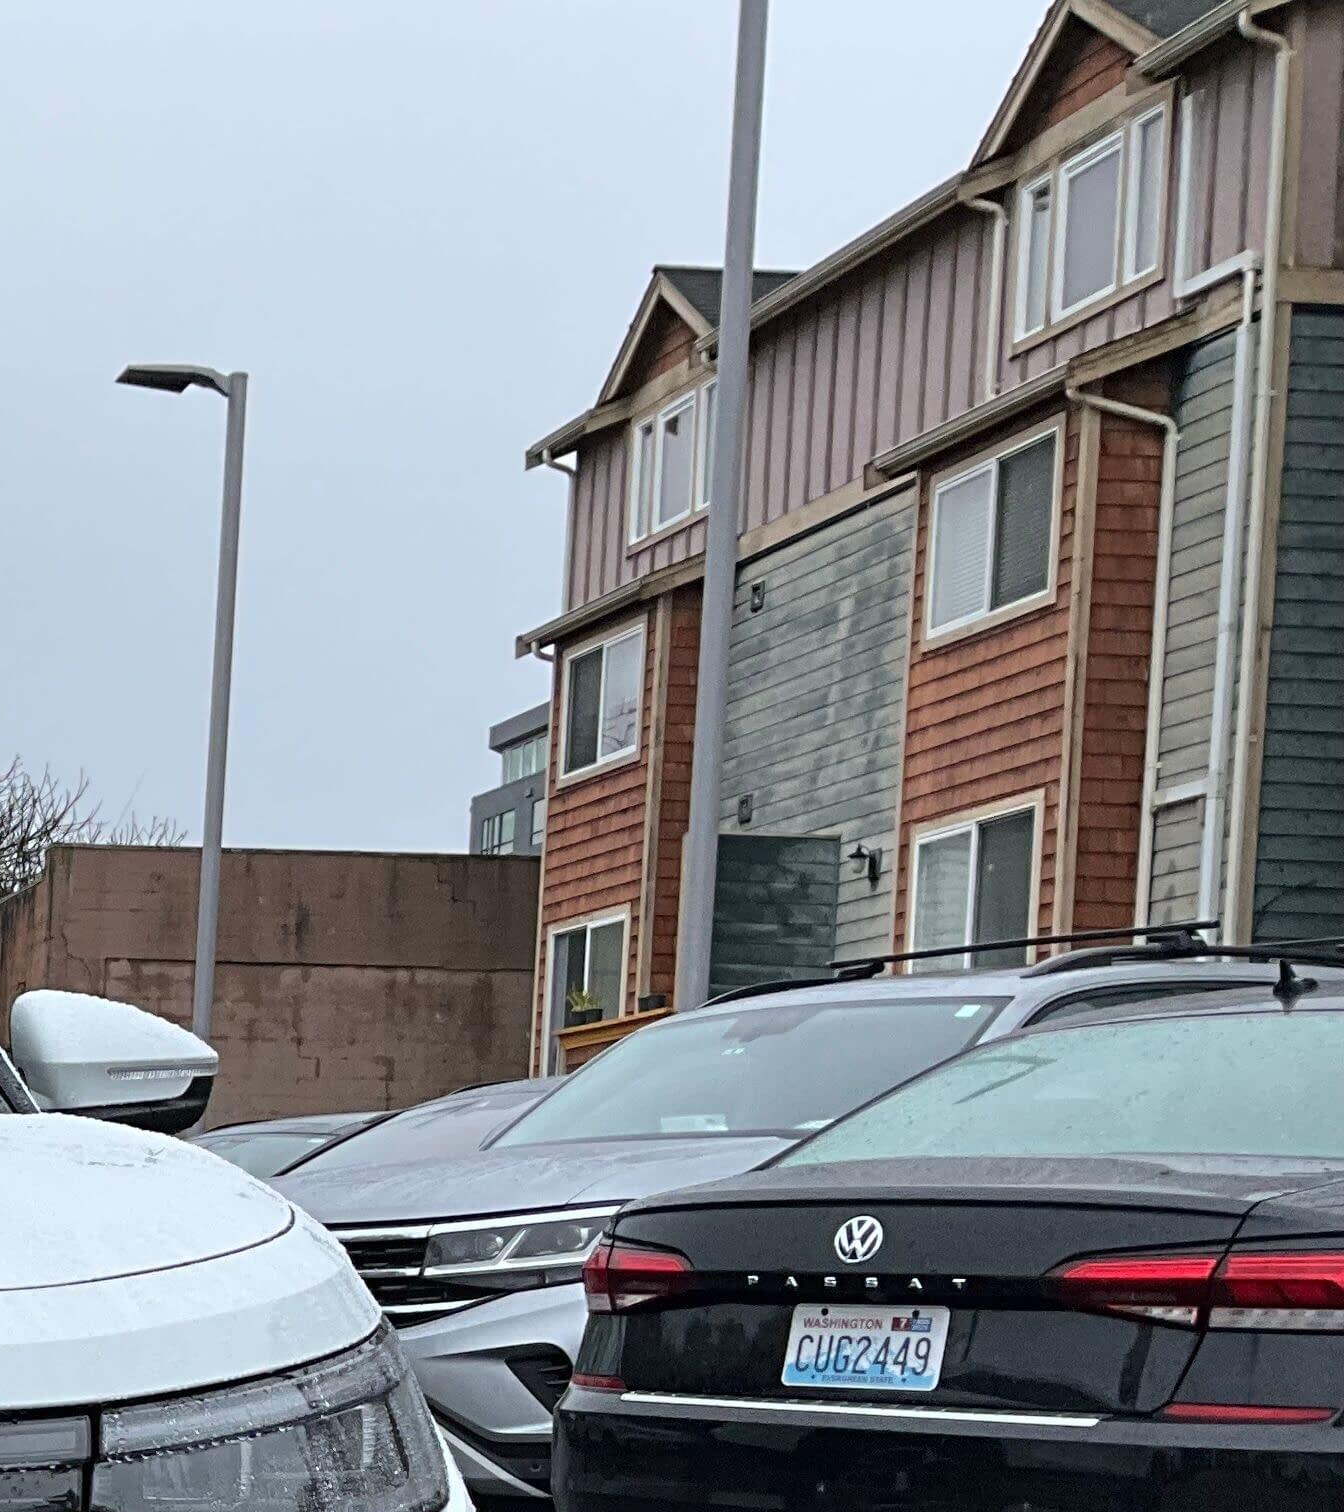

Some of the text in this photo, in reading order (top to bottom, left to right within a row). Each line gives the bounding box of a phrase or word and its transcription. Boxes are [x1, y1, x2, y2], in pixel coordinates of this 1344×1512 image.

[747, 1275, 967, 1290] PASSAT
[803, 1317, 883, 1330] WASHINGTON
[795, 1334, 932, 1376] CUG2449
